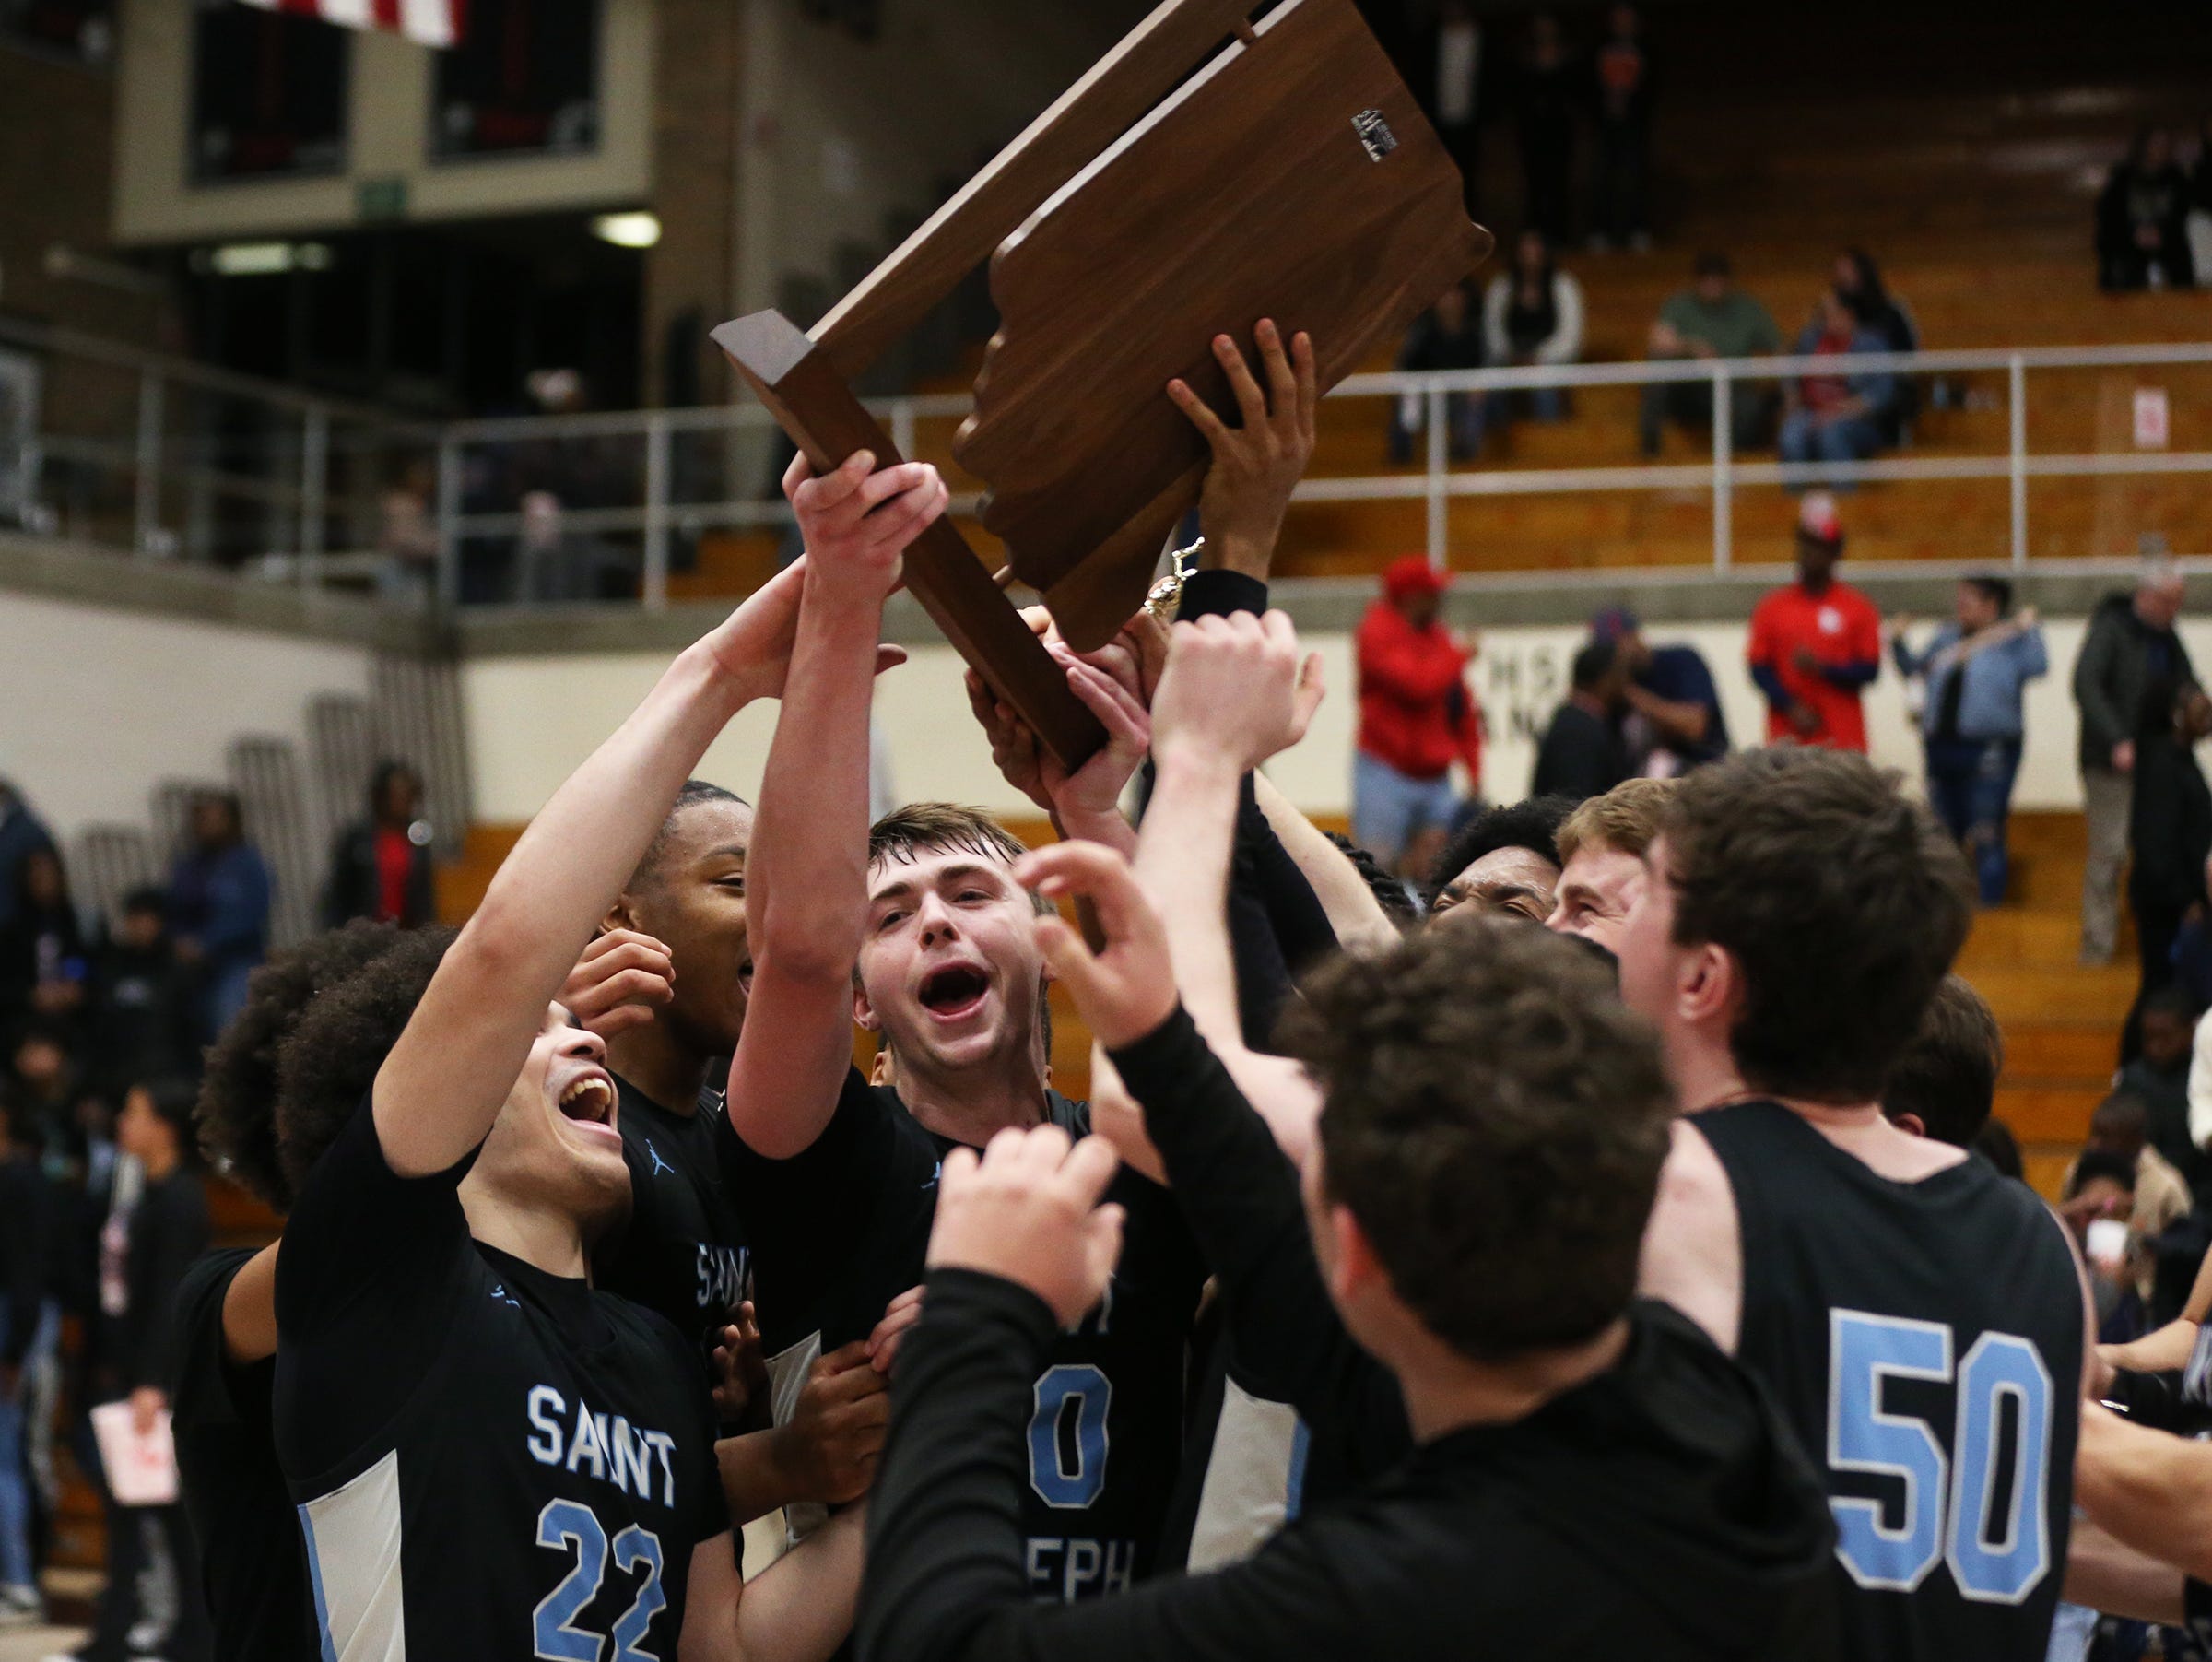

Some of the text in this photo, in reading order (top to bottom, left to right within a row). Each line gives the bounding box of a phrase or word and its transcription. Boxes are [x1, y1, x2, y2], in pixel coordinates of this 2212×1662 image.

[527, 1384, 677, 1509] SAINT
[1026, 1363, 1112, 1511] 0
[1827, 1306, 2054, 1606] 50
[532, 1497, 667, 1662] 22
